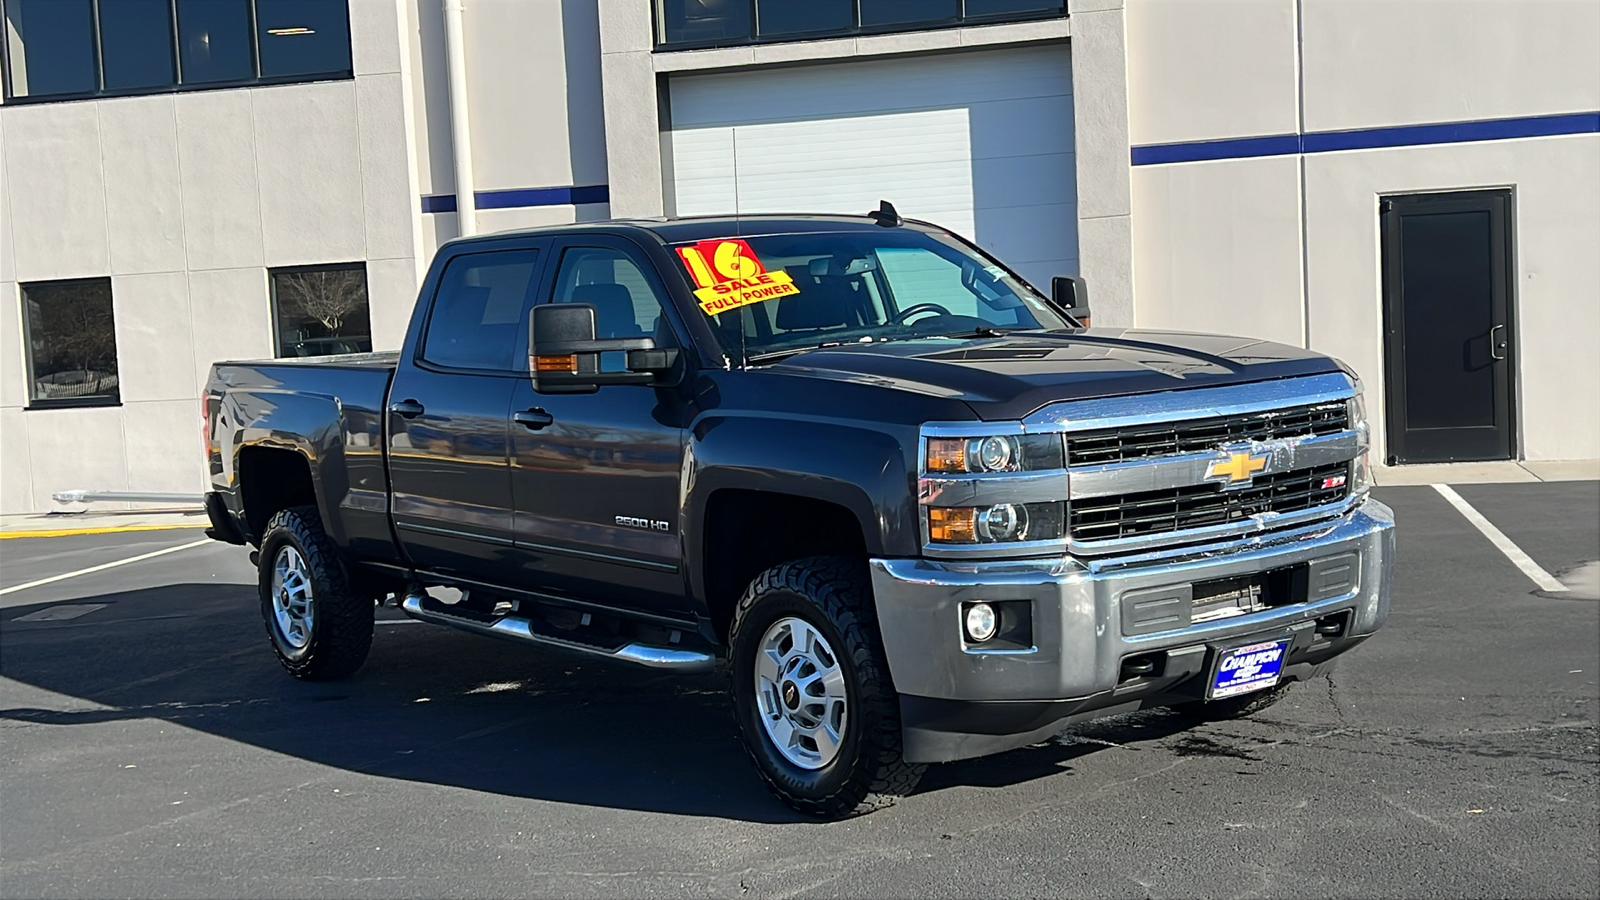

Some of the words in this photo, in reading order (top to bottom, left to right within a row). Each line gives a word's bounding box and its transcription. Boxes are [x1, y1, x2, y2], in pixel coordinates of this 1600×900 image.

[682, 241, 761, 288] 16
[712, 274, 775, 294] SALE
[704, 295, 742, 313] FULL
[742, 284, 793, 301] POWER
[615, 515, 649, 528] 2500
[650, 519, 669, 531] HD
